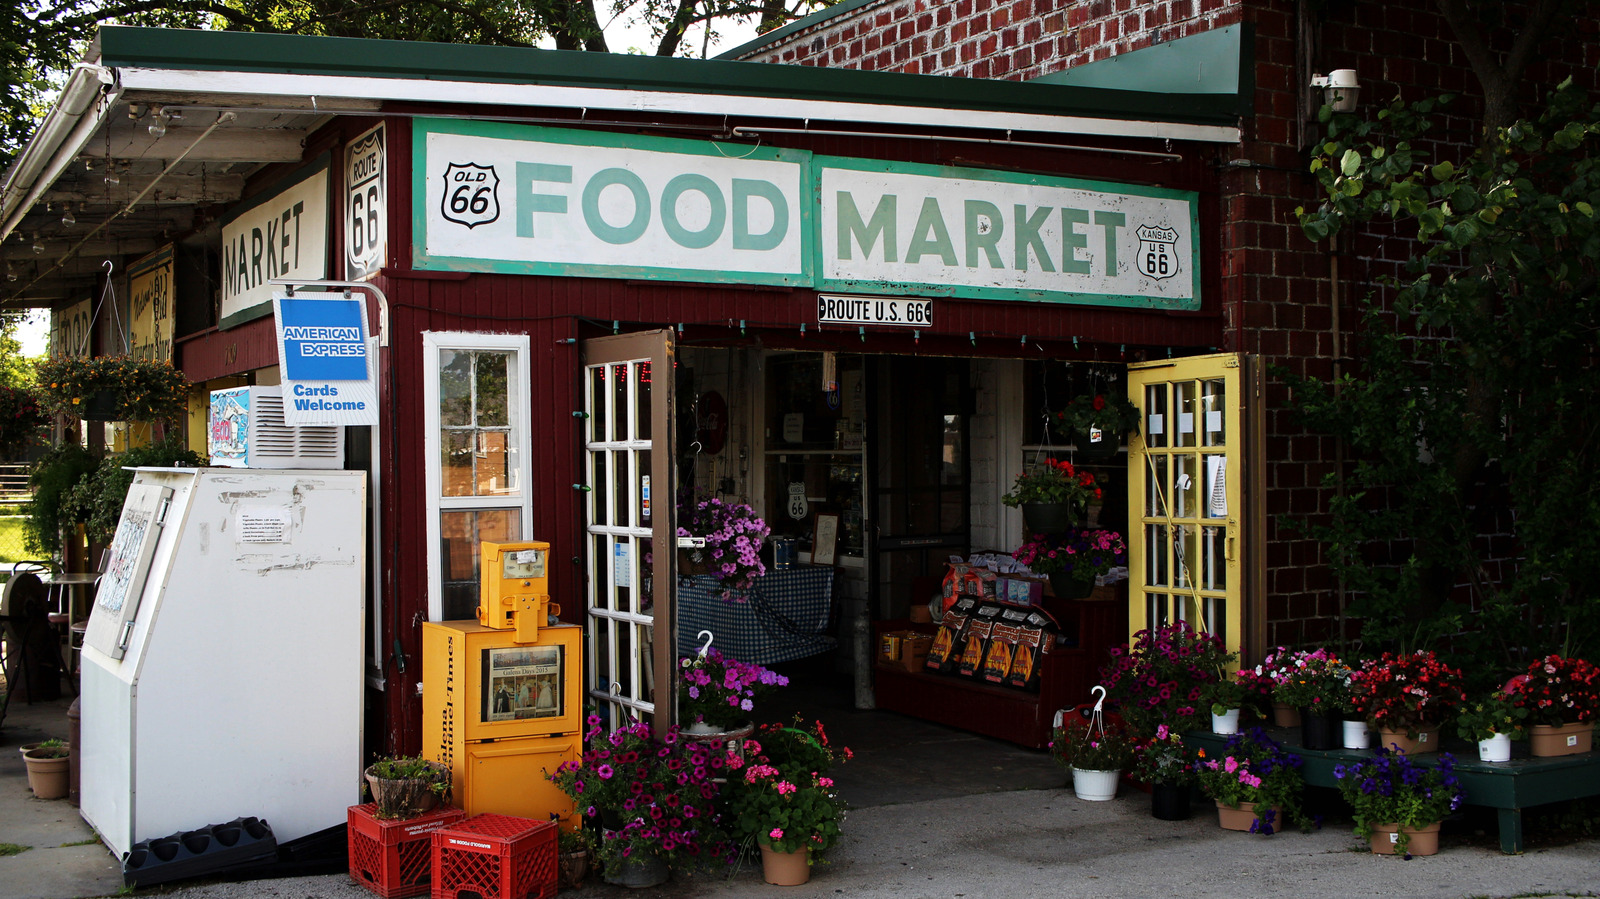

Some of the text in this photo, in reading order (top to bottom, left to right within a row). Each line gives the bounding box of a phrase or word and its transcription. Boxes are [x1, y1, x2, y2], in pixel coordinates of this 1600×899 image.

[353, 152, 377, 182] ROUTE
[454, 170, 487, 182] OLD
[450, 184, 491, 215] 66
[515, 160, 789, 252] FOOD
[352, 185, 378, 257] 66
[836, 190, 1126, 278] MARKET
[1141, 229, 1173, 241] KANSAS
[225, 200, 304, 301] MARKET
[1146, 252, 1168, 275] 66
[827, 299, 923, 322] ROUTE U.S. 66
[61, 311, 88, 357] FOOD
[283, 326, 360, 341] AMERICAN
[301, 342, 366, 357] EXPRESS
[293, 384, 338, 396] Cards
[294, 399, 366, 411] Welcome
[792, 502, 804, 515] 66
[522, 668, 535, 676] Days
[437, 708, 447, 764] alena
